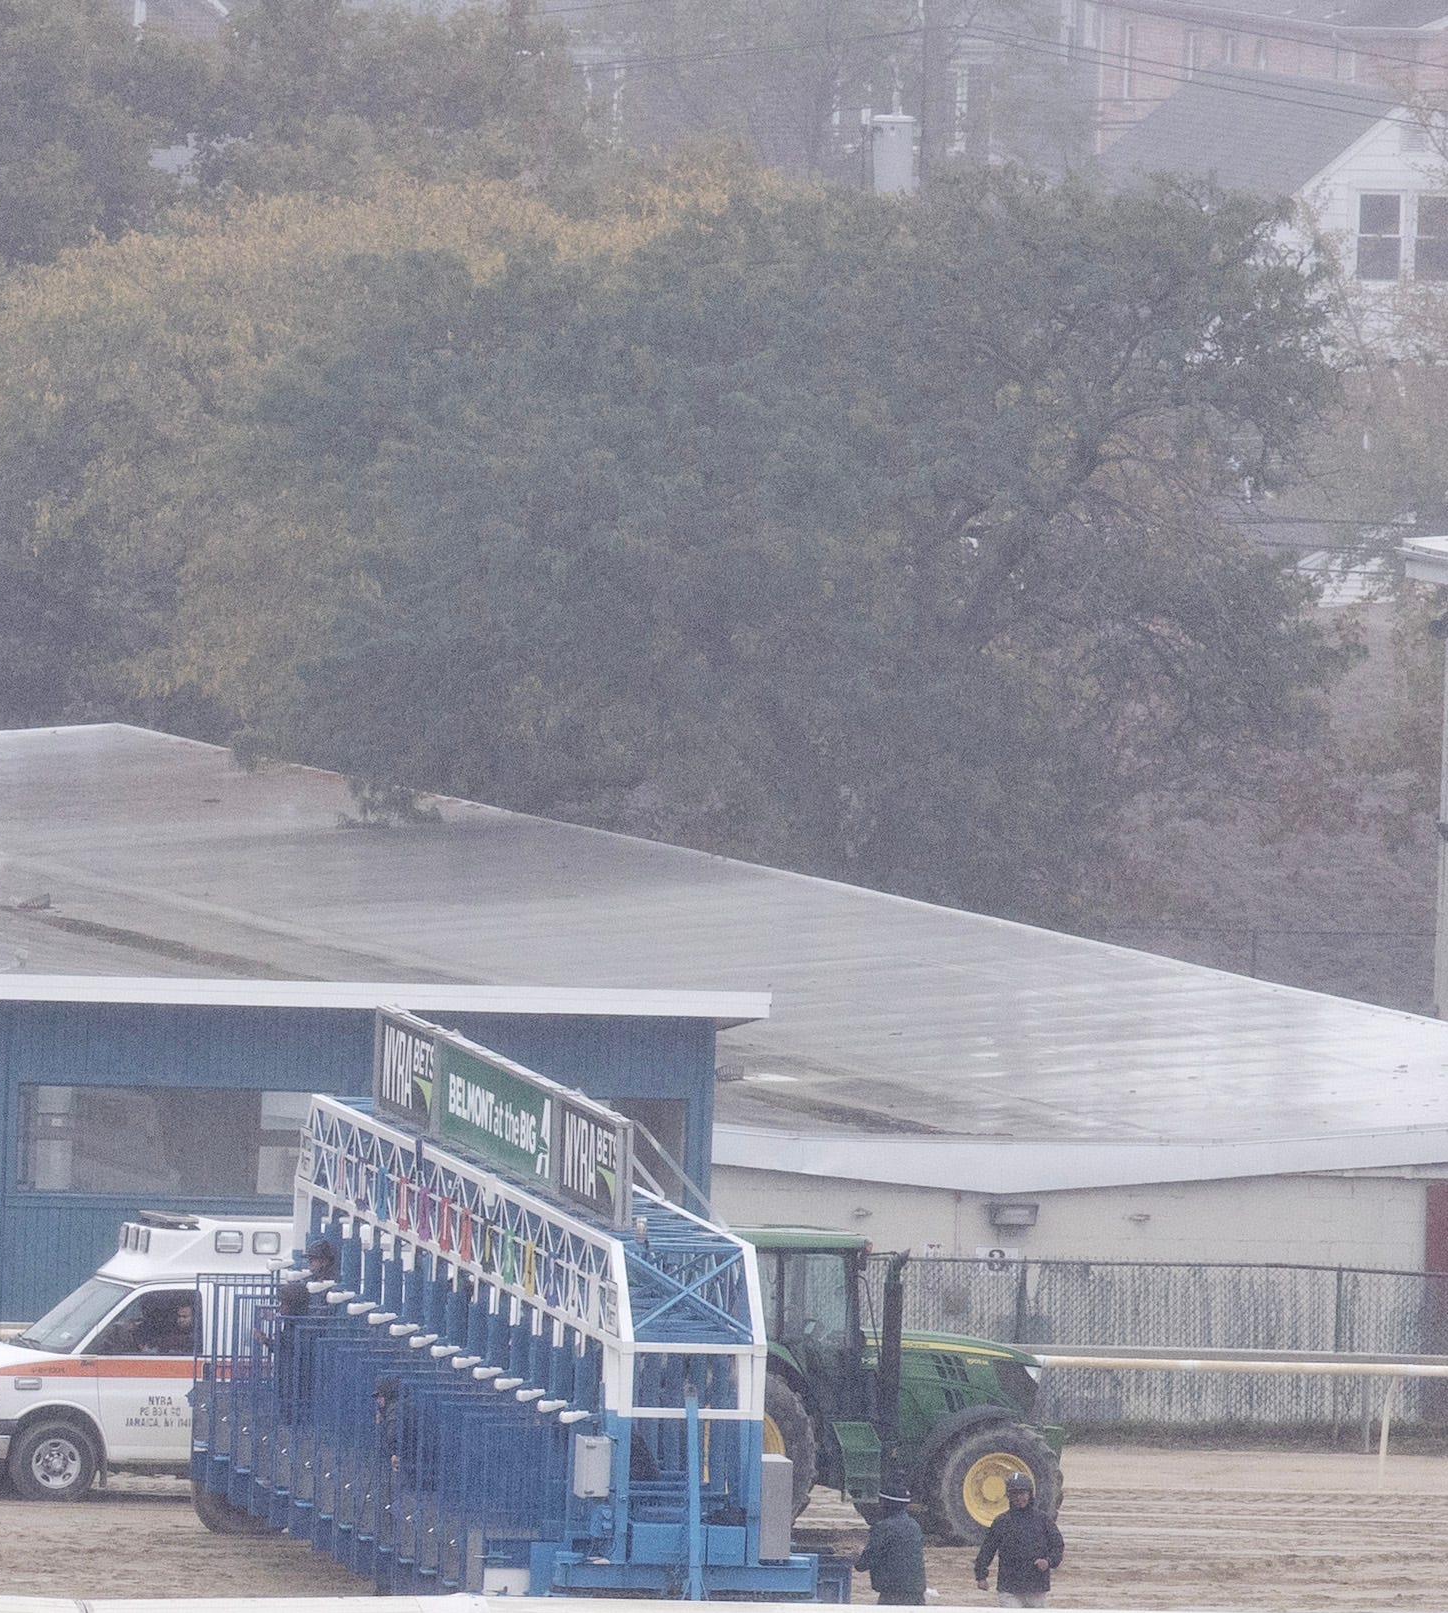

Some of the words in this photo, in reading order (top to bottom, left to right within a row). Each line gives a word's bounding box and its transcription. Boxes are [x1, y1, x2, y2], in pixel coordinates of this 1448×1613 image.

[382, 1024, 412, 1110] NYRA
[413, 1038, 434, 1079] BETS
[448, 1072, 495, 1133] BELMONT
[493, 1100, 503, 1138] at
[504, 1101, 519, 1146] the
[519, 1110, 537, 1155] BIG
[563, 1111, 596, 1199] NYRA
[987, 1248, 1006, 1272] 3
[148, 1395, 173, 1406] NYRA
[152, 1406, 168, 1417] BOX
[163, 1418, 174, 1427] NY
